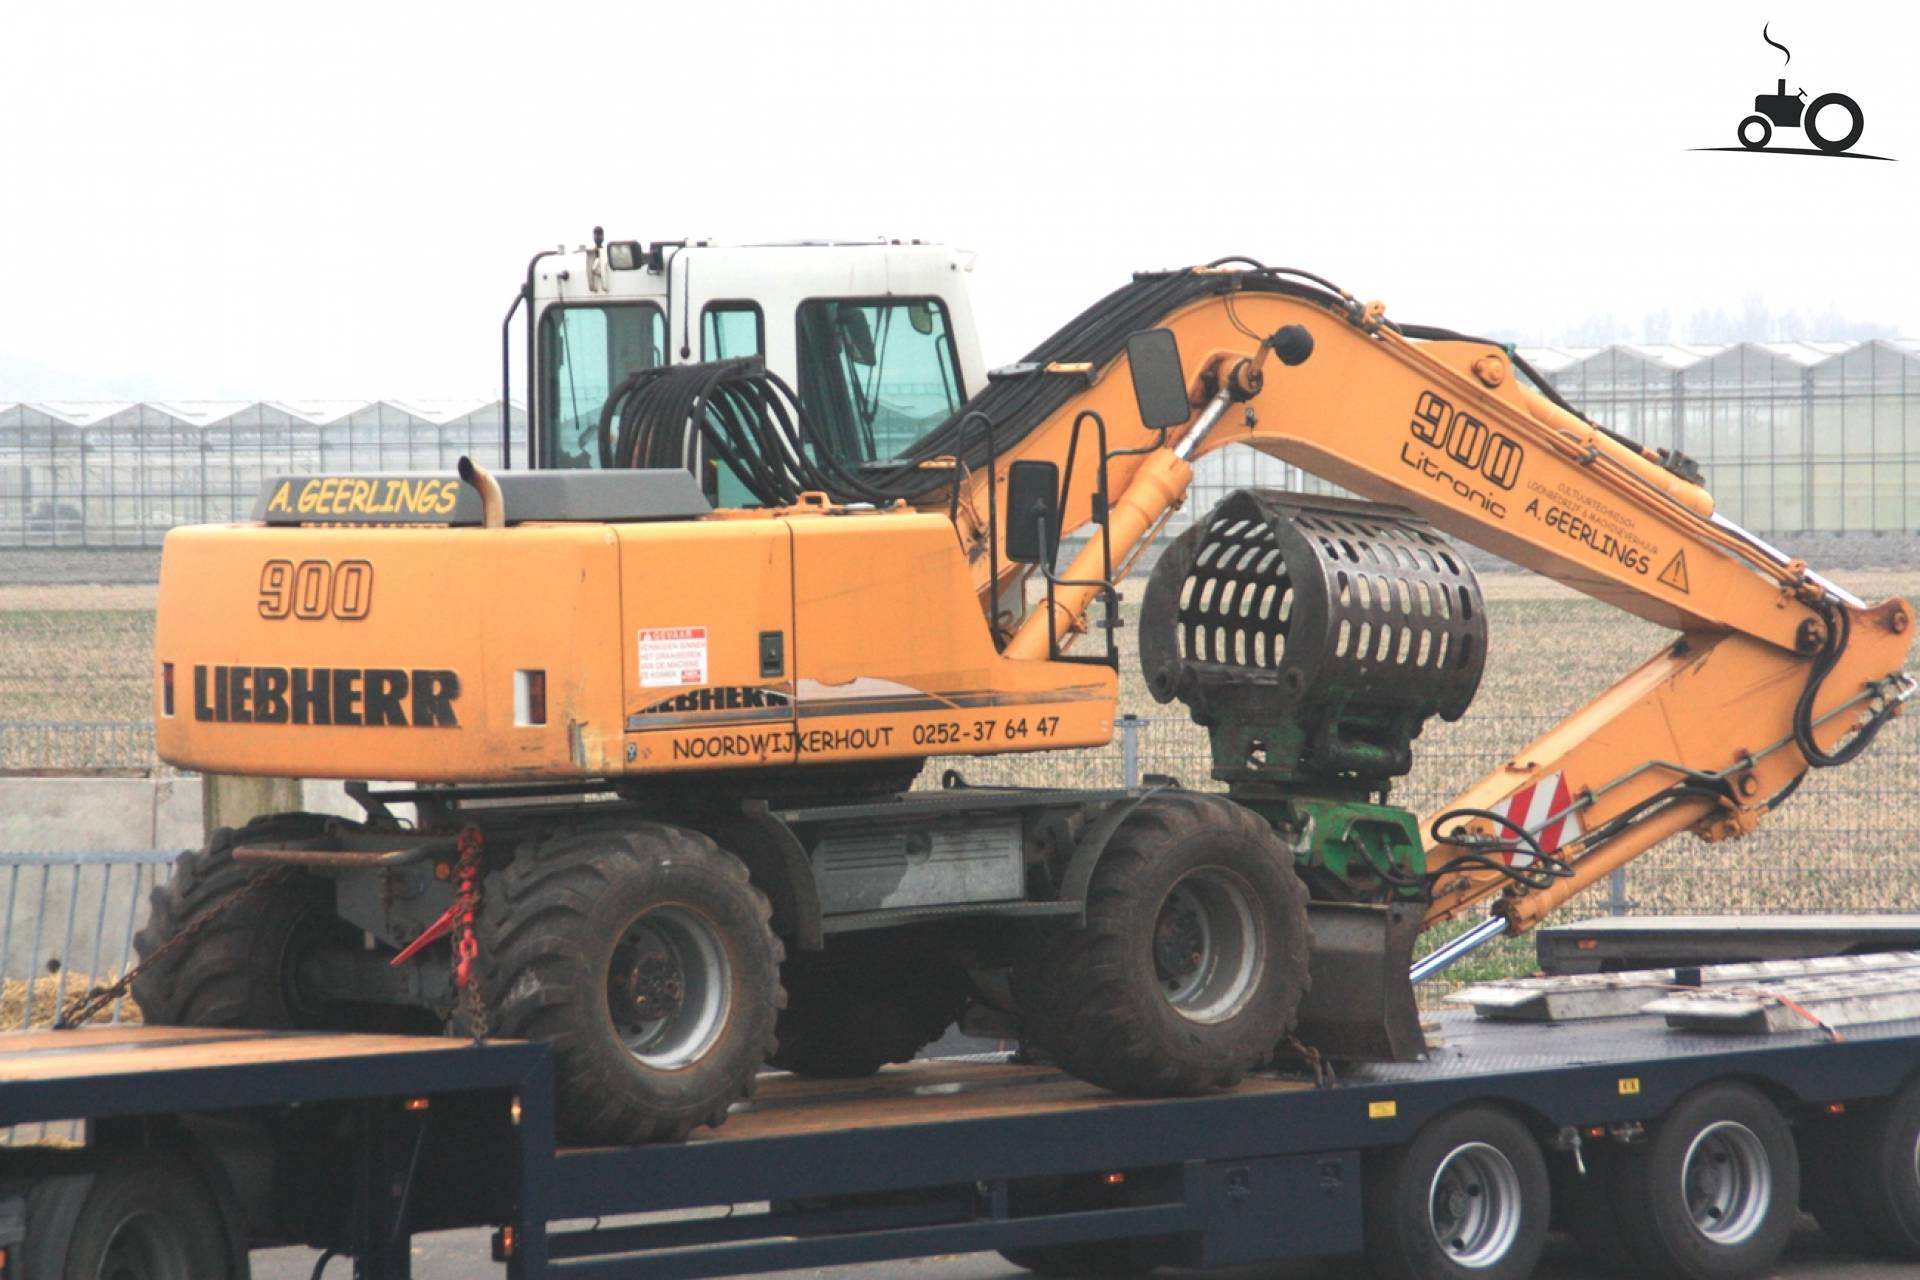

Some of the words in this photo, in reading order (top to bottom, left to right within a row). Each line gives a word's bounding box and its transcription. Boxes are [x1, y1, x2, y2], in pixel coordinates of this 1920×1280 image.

[1410, 389, 1524, 491] 900
[268, 480, 292, 513] A.
[297, 478, 459, 514] GEERLINGS
[1400, 441, 1506, 519] Litronic
[1525, 497, 1542, 521] A.
[1544, 505, 1652, 575] GEERLINGS
[258, 558, 375, 621] 900
[194, 664, 462, 729] LIEBHERR
[673, 726, 895, 760] NOORDWIJKERHOUT
[913, 720, 997, 746] 0252-37
[1005, 718, 1029, 740] 64
[1036, 716, 1061, 738] 47
